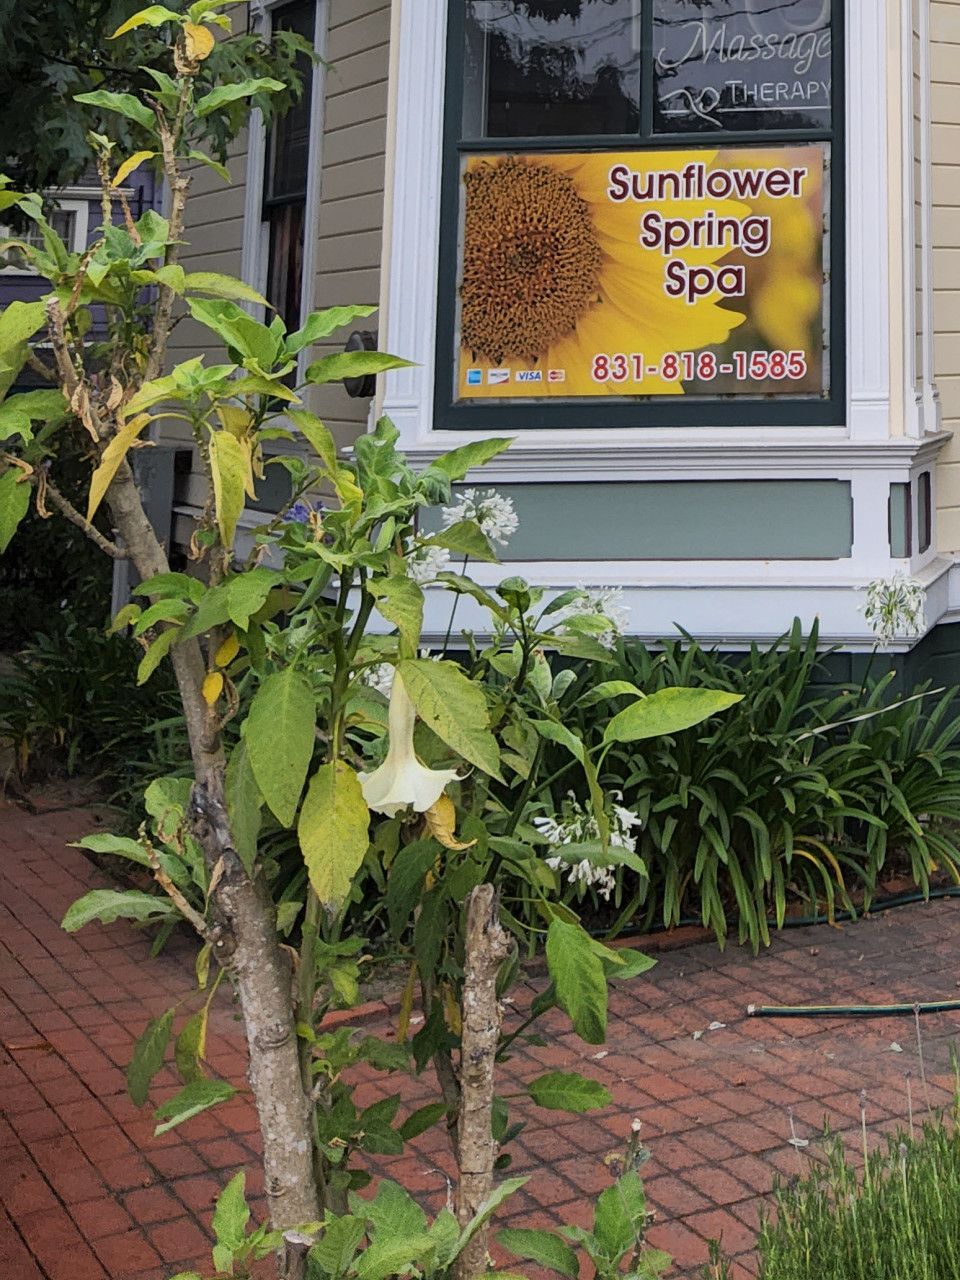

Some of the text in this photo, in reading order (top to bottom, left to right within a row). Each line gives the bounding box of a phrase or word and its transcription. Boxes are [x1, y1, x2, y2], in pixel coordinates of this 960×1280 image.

[657, 19, 832, 75] Massage
[725, 79, 832, 103] THERAPY
[608, 164, 806, 201] Sunflower
[641, 212, 771, 255] Spring
[665, 261, 746, 303] Spa
[518, 371, 542, 381] VISA
[592, 351, 807, 382] 831-818-1585
